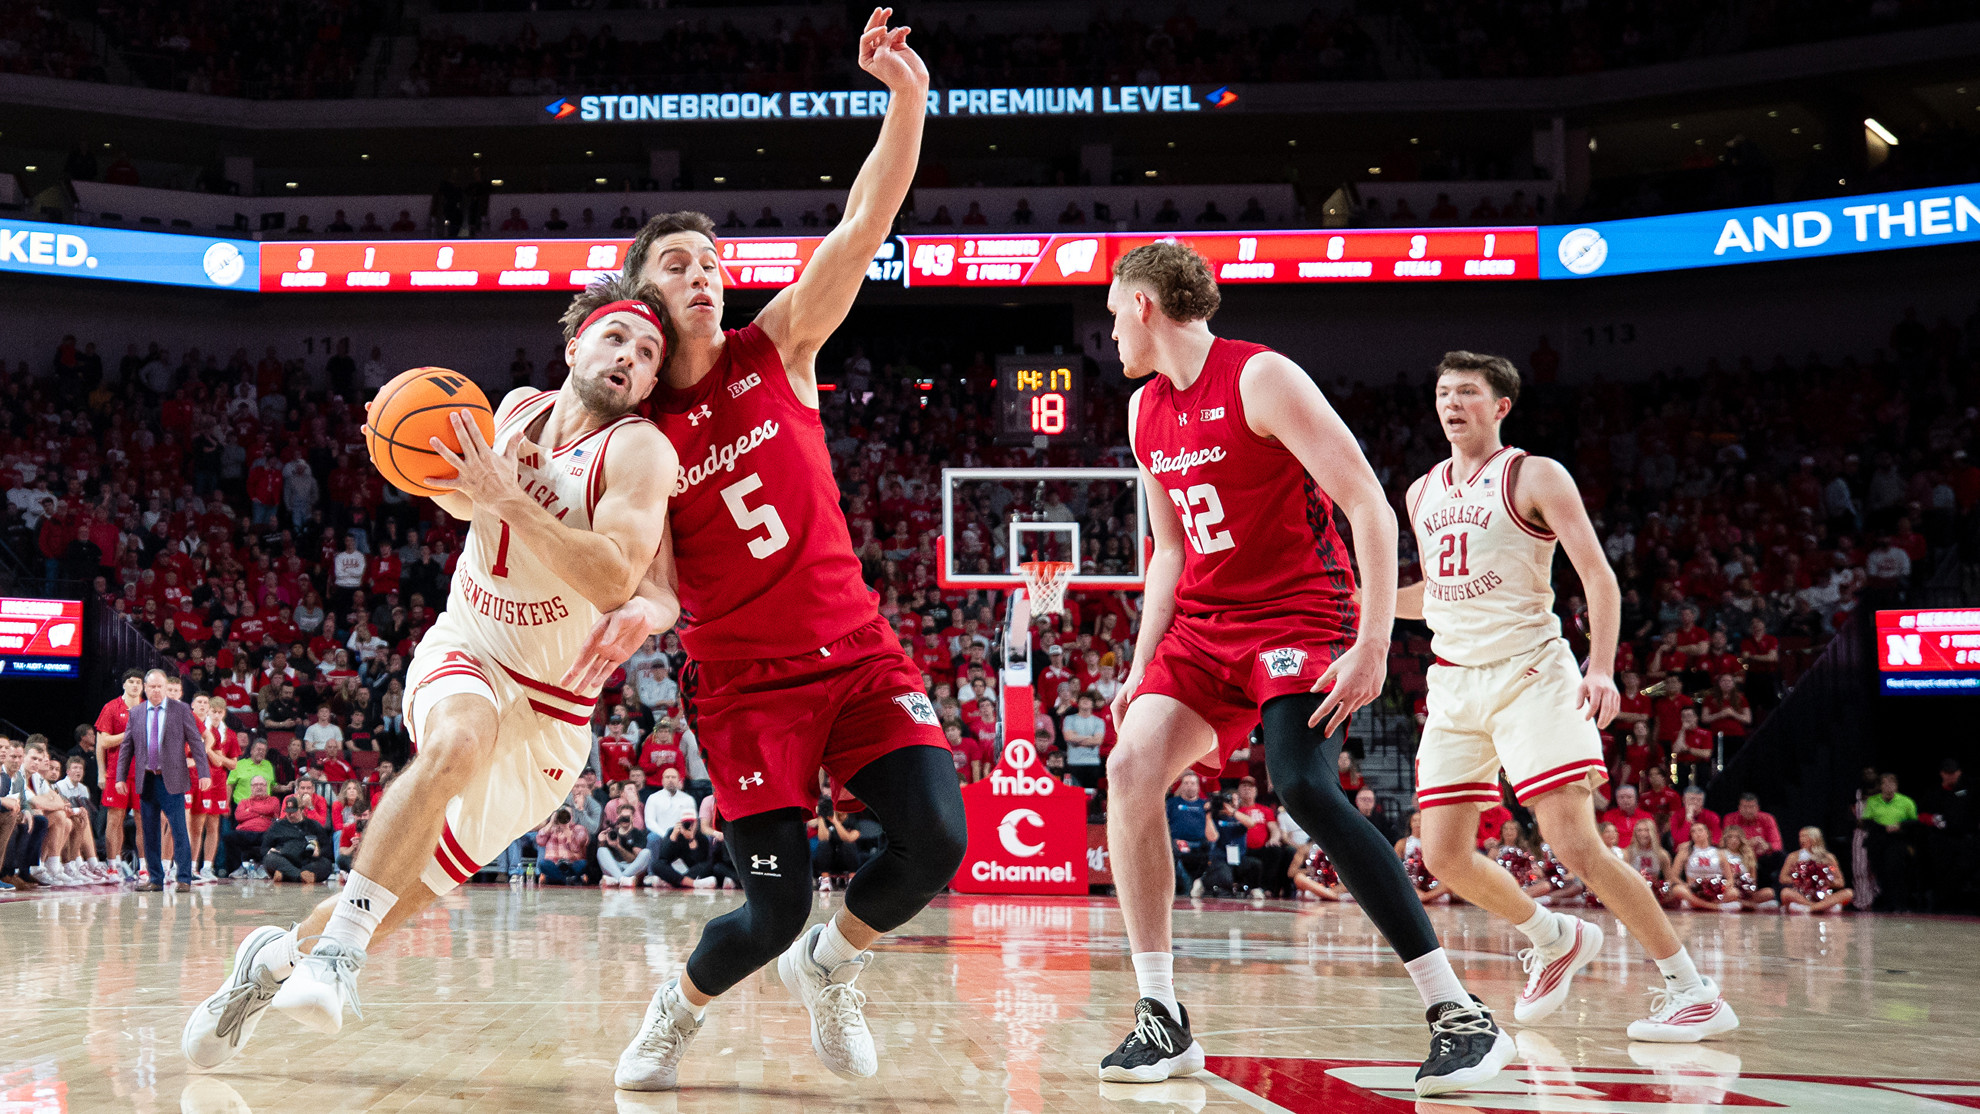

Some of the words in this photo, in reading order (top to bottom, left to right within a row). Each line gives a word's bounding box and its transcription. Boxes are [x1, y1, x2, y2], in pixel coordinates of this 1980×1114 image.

[580, 92, 782, 121] STONEBROOK
[790, 91, 941, 117] EXTERR
[949, 87, 1094, 115] PREMIUM
[1102, 85, 1200, 113] LEVEL
[1408, 235, 1427, 259] 3
[1483, 233, 1496, 258] 1
[1714, 210, 1833, 255] AND
[0, 228, 98, 270] KED.
[297, 247, 315, 271] 3
[363, 247, 376, 270] 1
[912, 244, 955, 276] 43
[1238, 237, 1257, 261] 11
[1017, 368, 1072, 391] 14:17
[1031, 392, 1066, 435] 18
[669, 419, 779, 498] Badgers
[1150, 446, 1227, 476] Badgers
[720, 472, 790, 560] 5
[1169, 482, 1236, 555] 22
[1423, 505, 1493, 537] NEBRASKA
[492, 519, 510, 578] 1
[1439, 532, 1470, 577] 21
[1886, 634, 1923, 666] N
[990, 769, 1055, 796] fnbo
[971, 860, 1073, 883] Channel
